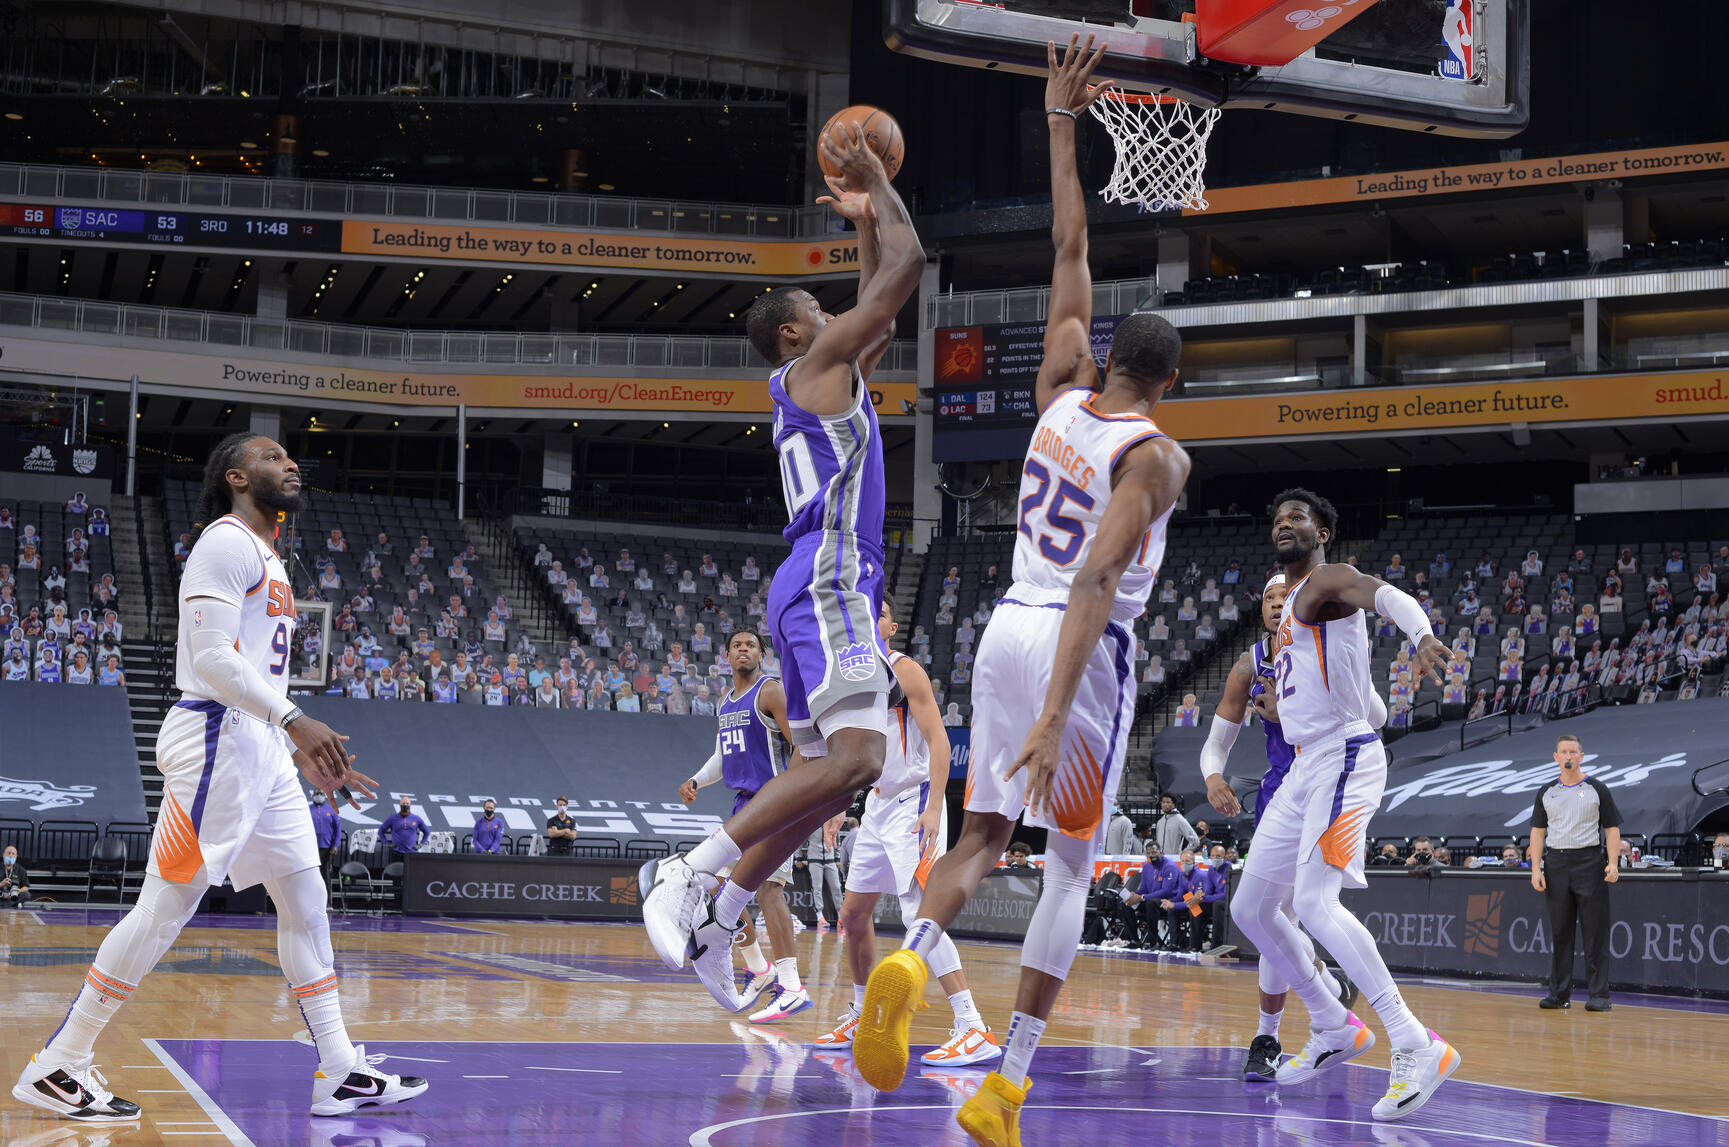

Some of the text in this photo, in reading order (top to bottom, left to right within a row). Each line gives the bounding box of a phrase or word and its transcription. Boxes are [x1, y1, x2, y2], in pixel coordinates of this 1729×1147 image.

[1444, 60, 1460, 75] NBA
[1356, 149, 1726, 194] Leading the way to a cleaner tomorrow.
[24, 209, 44, 223] 56
[86, 212, 118, 226] SAC
[157, 216, 177, 230] 53
[13, 227, 50, 236] FOULS 00
[200, 220, 227, 232] 3RD
[246, 220, 289, 235] 11:48
[302, 225, 313, 235] 12
[60, 229, 96, 238] TIMEOUTS
[147, 233, 170, 242] FOULS
[372, 228, 756, 265] Leading the way to a cleaner tomorrow.
[829, 247, 859, 265] SM
[1000, 326, 1038, 336] ADVANCED
[1093, 321, 1114, 329] KINGS
[950, 332, 968, 340] SUNS
[1008, 342, 1038, 350] EFFECTIVE
[222, 364, 461, 397] Powering a cleaner future.
[524, 381, 735, 406] smud.org/CleanEnergy
[950, 394, 967, 402] DAL
[979, 392, 993, 401] 124
[1013, 391, 1031, 399] BKN
[950, 405, 966, 413] LAC
[981, 404, 991, 412] 73
[1013, 401, 1030, 410] CHA
[1277, 390, 1570, 423] Powering a cleaner future.
[23, 455, 57, 467] Sports
[1033, 426, 1095, 490] BRIDGES
[779, 431, 821, 523] 0
[1018, 457, 1096, 567] 25
[840, 655, 875, 671] SAC
[719, 709, 751, 730] SAC
[721, 728, 746, 755] 24
[426, 880, 604, 902] CACHE CREEK
[991, 899, 1033, 919] RESORT
[1364, 911, 1457, 948] CREEK
